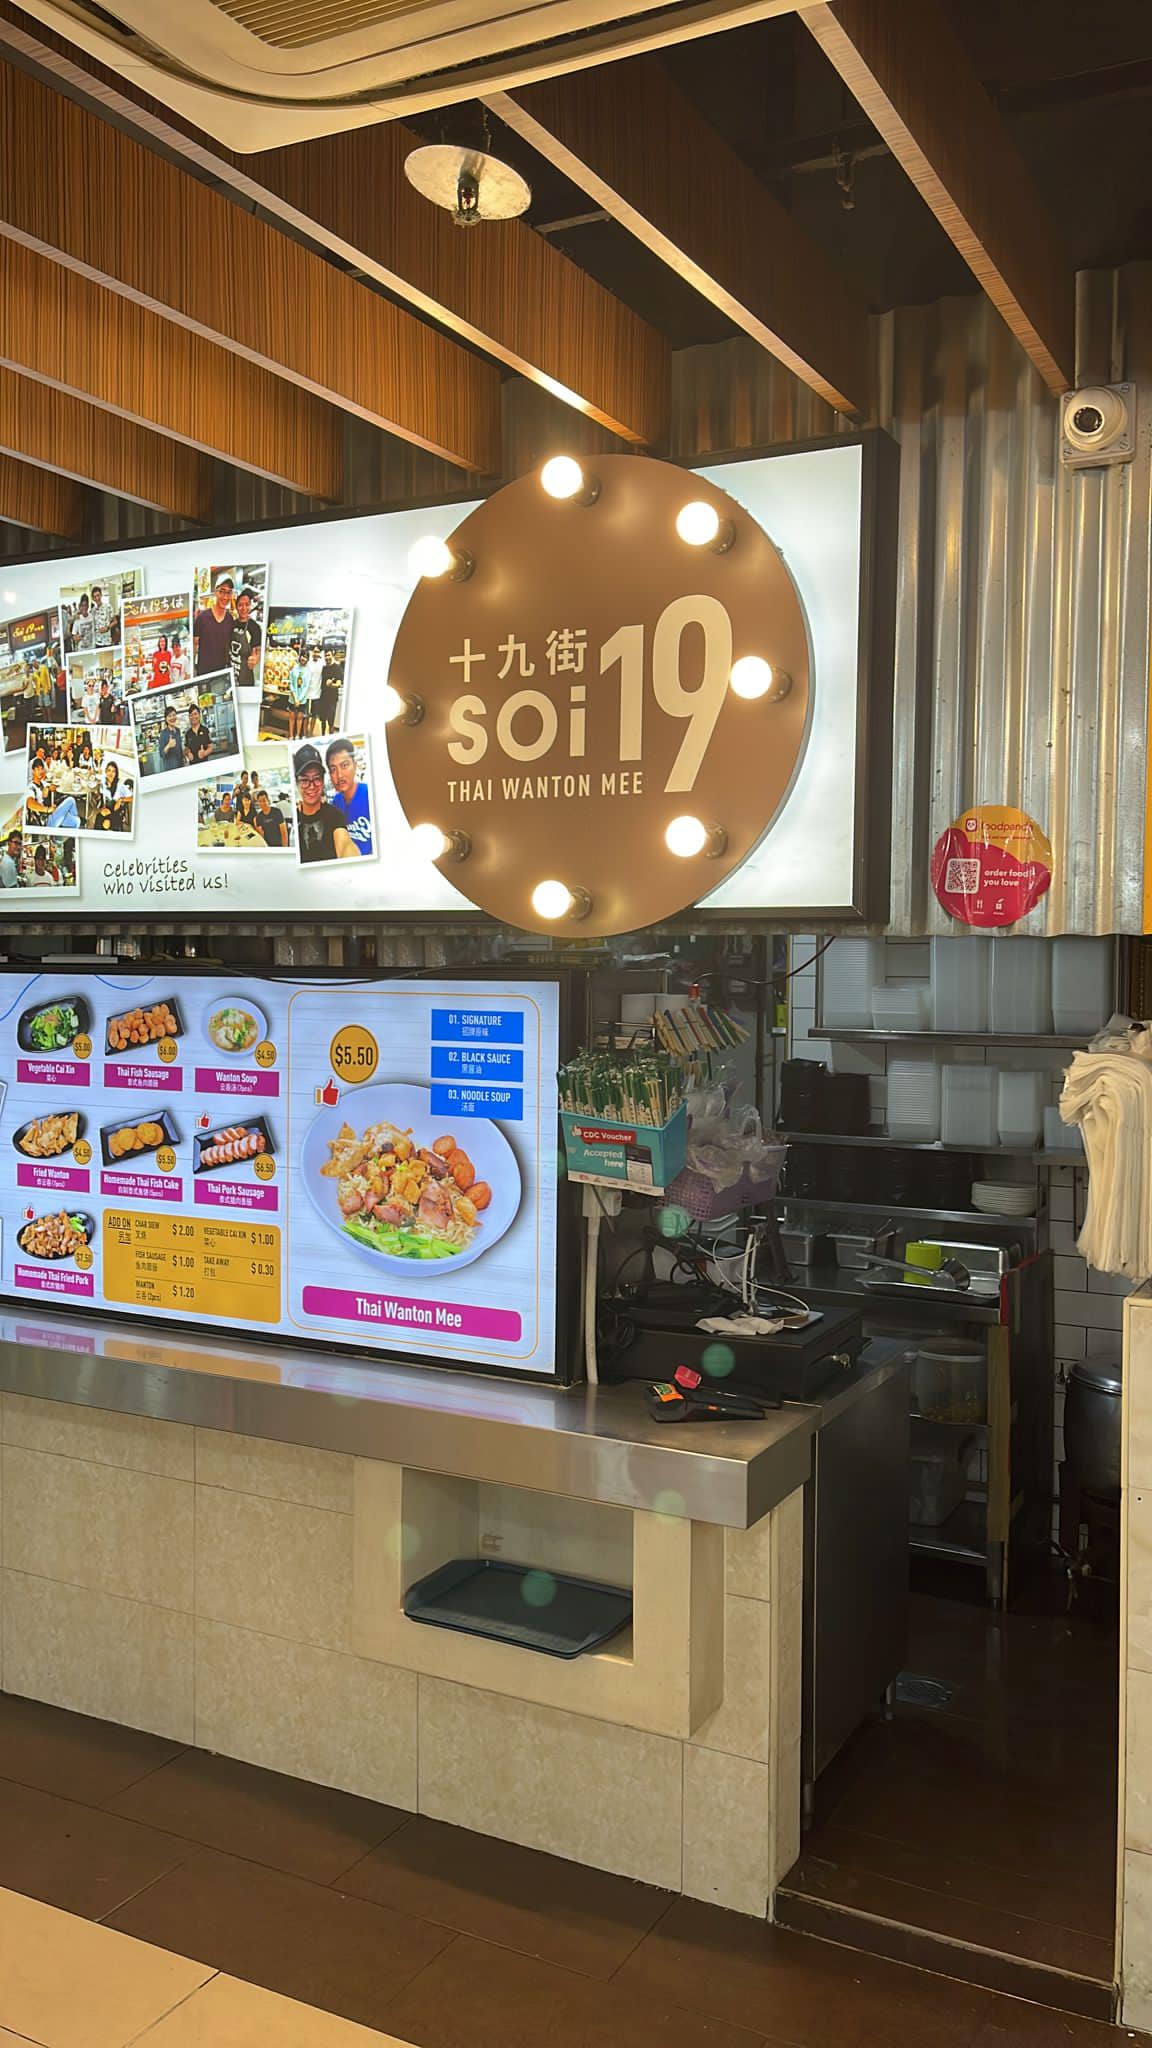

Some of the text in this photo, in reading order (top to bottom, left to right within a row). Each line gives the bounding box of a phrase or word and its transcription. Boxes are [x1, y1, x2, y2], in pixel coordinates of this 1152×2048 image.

[449, 628, 588, 683] 十九街
[600, 594, 732, 793] 19
[447, 772, 643, 803] THAI WANTON MEE
[103, 856, 188, 877] Celebrities
[984, 868, 1029, 877] order food
[103, 872, 228, 895] who visited us!
[984, 878, 1019, 887] you love
[462, 1015, 502, 1025] SIGNATURE
[335, 1044, 374, 1067] $5.50
[461, 1052, 485, 1063] BLACK
[487, 1054, 511, 1064] SAUCE
[28, 1063, 55, 1074] Vegetable
[117, 1067, 169, 1080] Thai Fish Sausage
[216, 1071, 257, 1085] Wanton Soup
[461, 1090, 489, 1101] NOODLE
[491, 1092, 511, 1102] SOUP
[583, 1130, 632, 1141] CDC Voucher
[584, 1149, 623, 1159] Accepted
[604, 1160, 625, 1168] here
[33, 1167, 70, 1179] Fried Wanton
[104, 1174, 179, 1190] Homemade Thai Fish Cake
[207, 1183, 265, 1199] Thai Pork Sausage
[109, 1216, 131, 1228] ADD ON
[17, 1266, 88, 1285] Homemade Thai Fried Pork
[355, 1298, 462, 1328] Thai Wanton Mee
